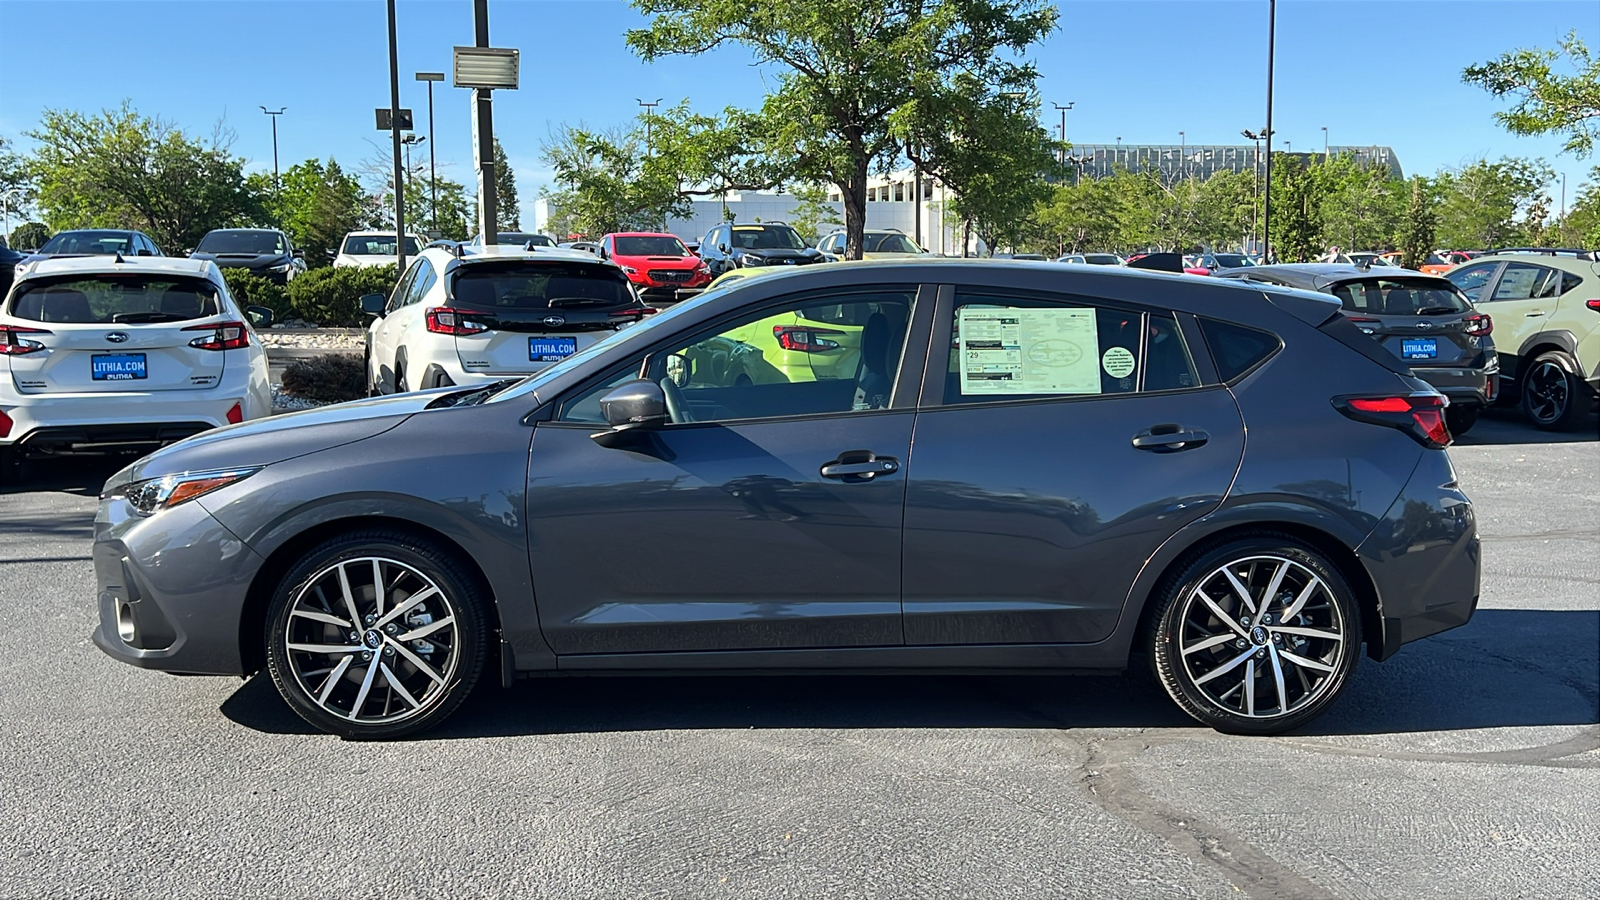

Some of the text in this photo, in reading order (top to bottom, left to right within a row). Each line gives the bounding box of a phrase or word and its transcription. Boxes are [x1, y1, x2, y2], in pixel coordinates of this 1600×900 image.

[530, 344, 575, 354] LITHIA.COM
[1403, 344, 1436, 353] LITHIA.COM
[969, 351, 979, 359] 29
[93, 361, 145, 372] LITHIA.COM
